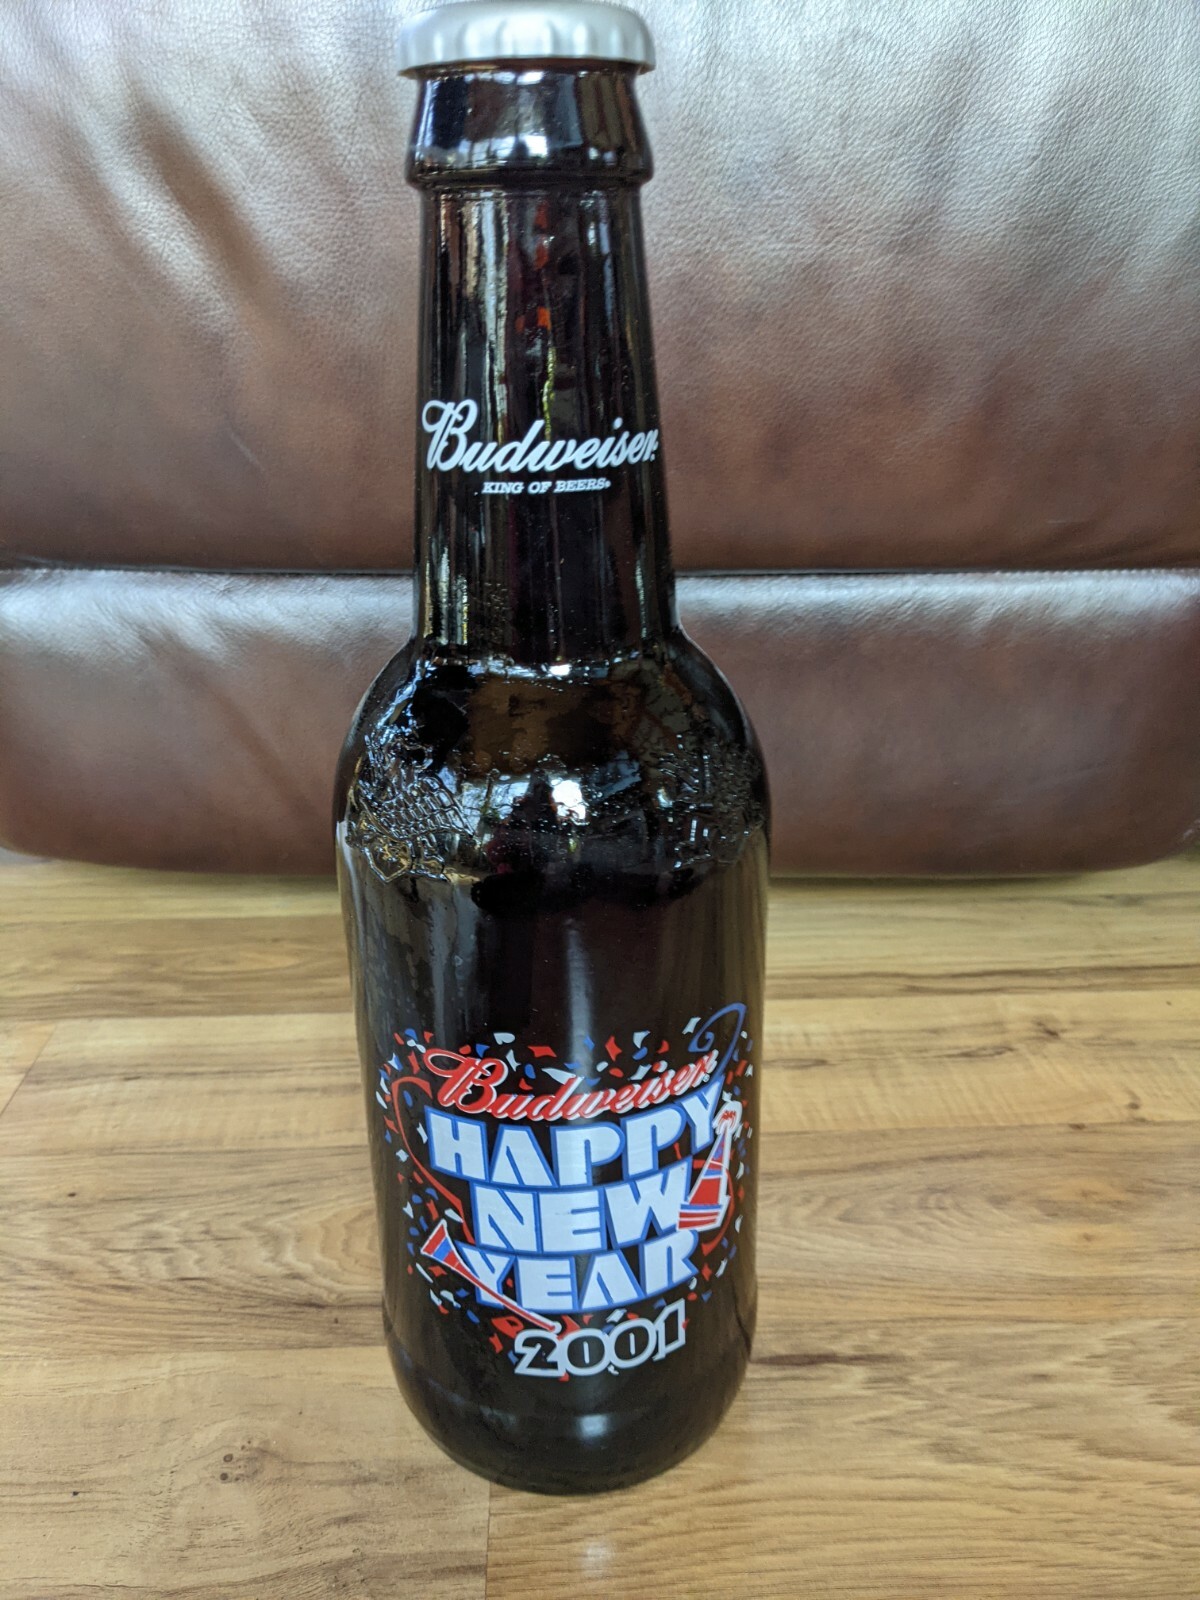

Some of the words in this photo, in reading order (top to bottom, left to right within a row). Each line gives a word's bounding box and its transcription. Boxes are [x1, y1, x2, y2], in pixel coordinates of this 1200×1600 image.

[421, 399, 659, 473] Budweiser
[482, 481, 524, 494] KING
[528, 481, 552, 494] OF
[554, 478, 611, 493] BEERS
[424, 1048, 719, 1121] Budweiser
[424, 1077, 726, 1188] HAPPY
[470, 1155, 693, 1253] NEW
[455, 1230, 699, 1313] YEAR
[514, 1298, 686, 1376] 2001
